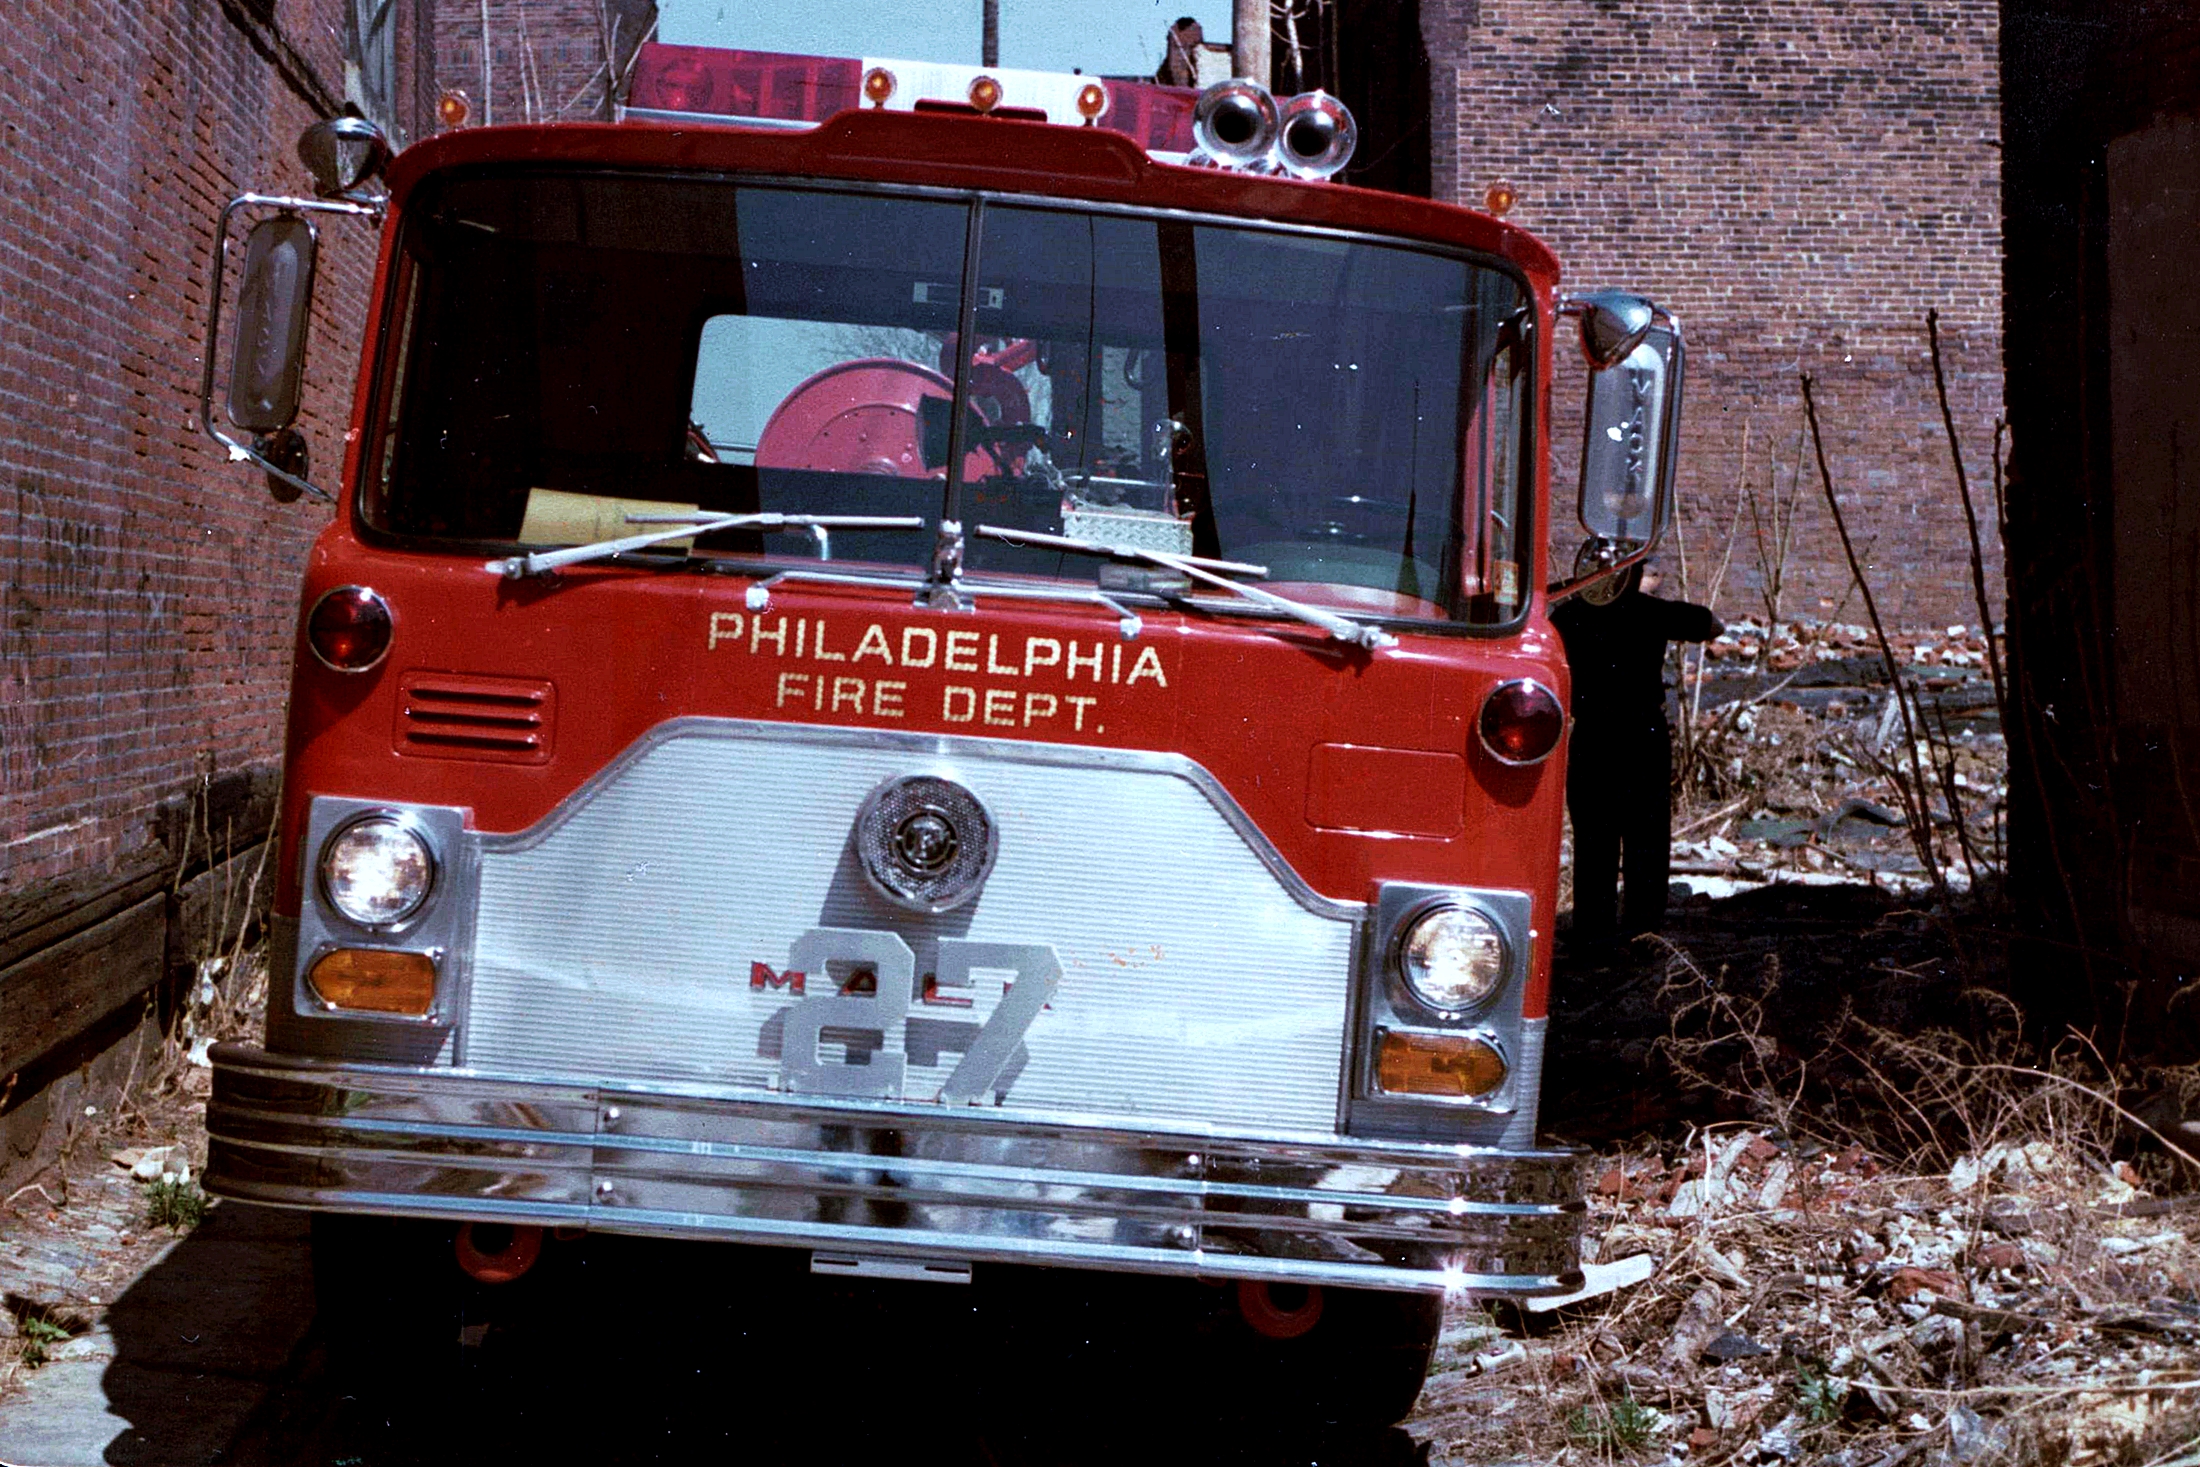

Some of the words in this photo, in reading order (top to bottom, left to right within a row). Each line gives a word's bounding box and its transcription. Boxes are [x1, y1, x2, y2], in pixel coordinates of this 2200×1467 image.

[708, 611, 1168, 688] PHILADELPHIA
[776, 672, 907, 717] FIRE
[942, 685, 1105, 734] DEPT.
[750, 960, 1053, 1011] MAC
[780, 926, 1065, 1101] 27
